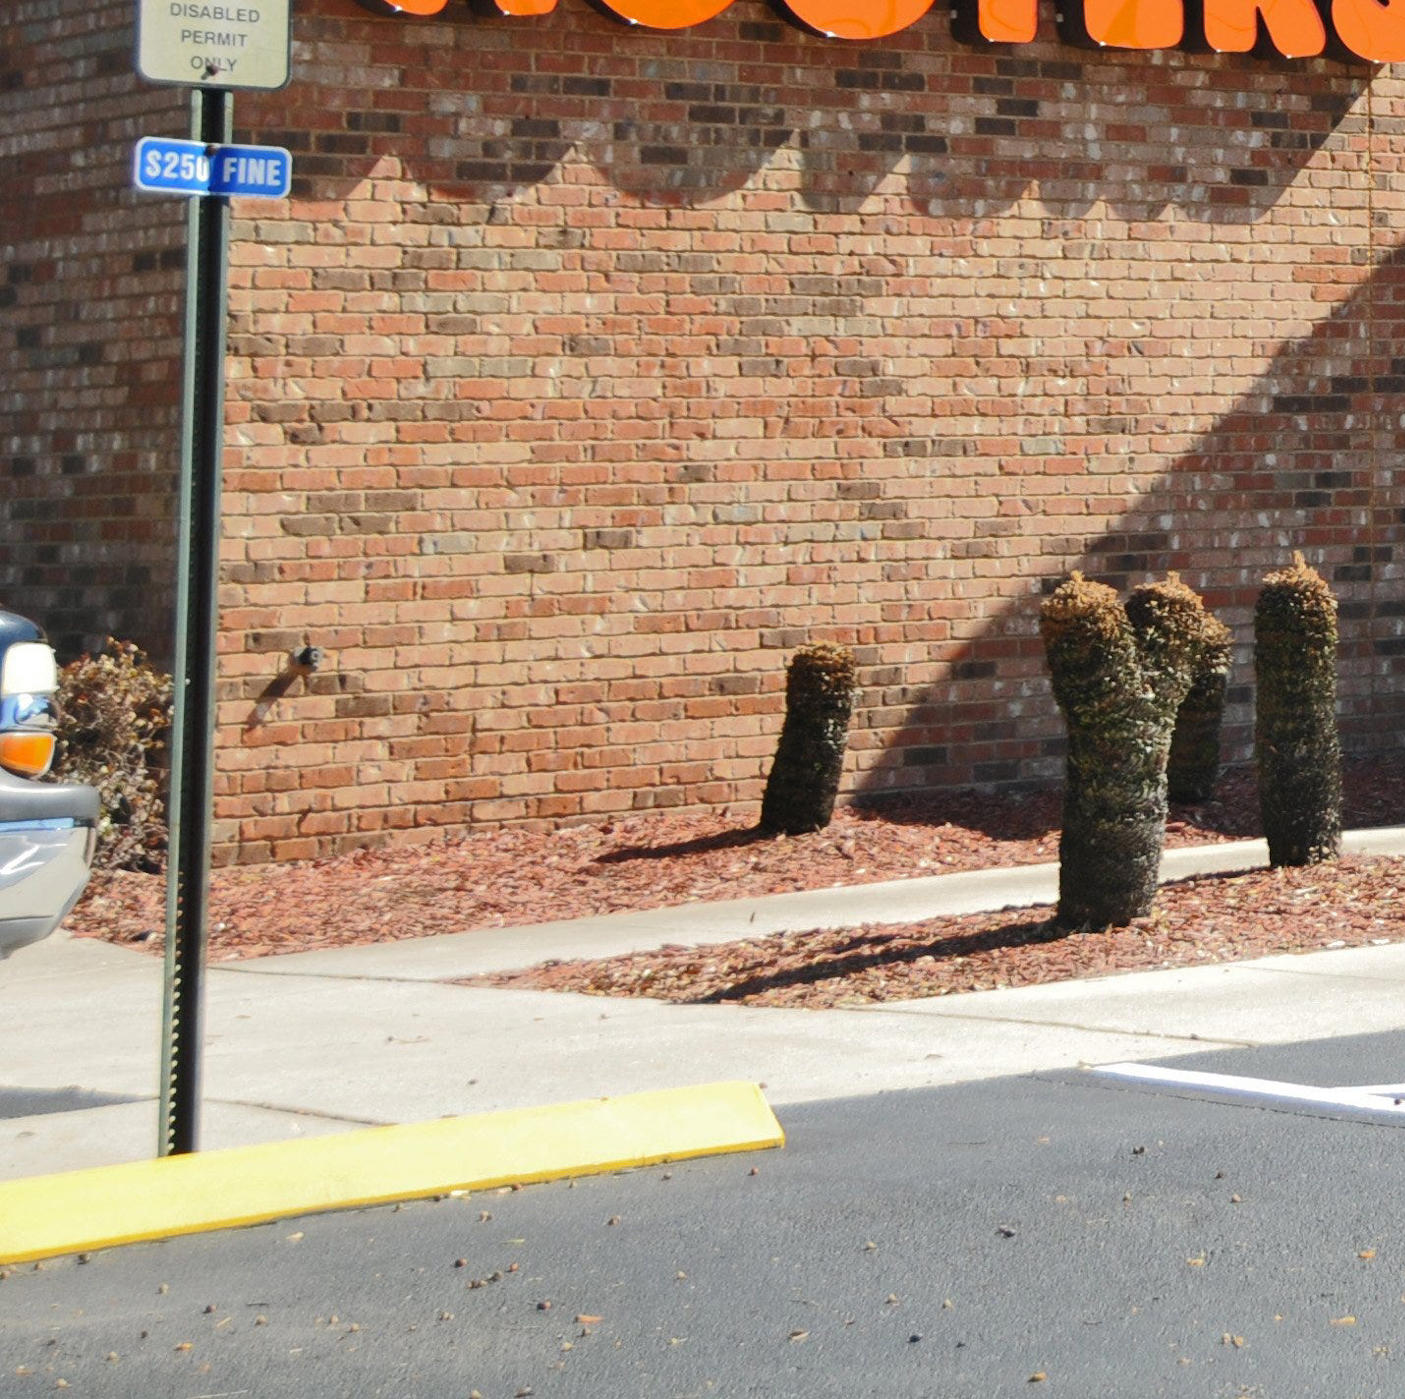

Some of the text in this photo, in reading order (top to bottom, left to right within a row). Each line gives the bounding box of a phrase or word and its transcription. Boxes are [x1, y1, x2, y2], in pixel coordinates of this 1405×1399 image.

[170, 2, 261, 23] DISABLED
[181, 28, 248, 47] PERMIT
[190, 55, 238, 72] ONLY
[145, 149, 282, 187] $250 FINE
